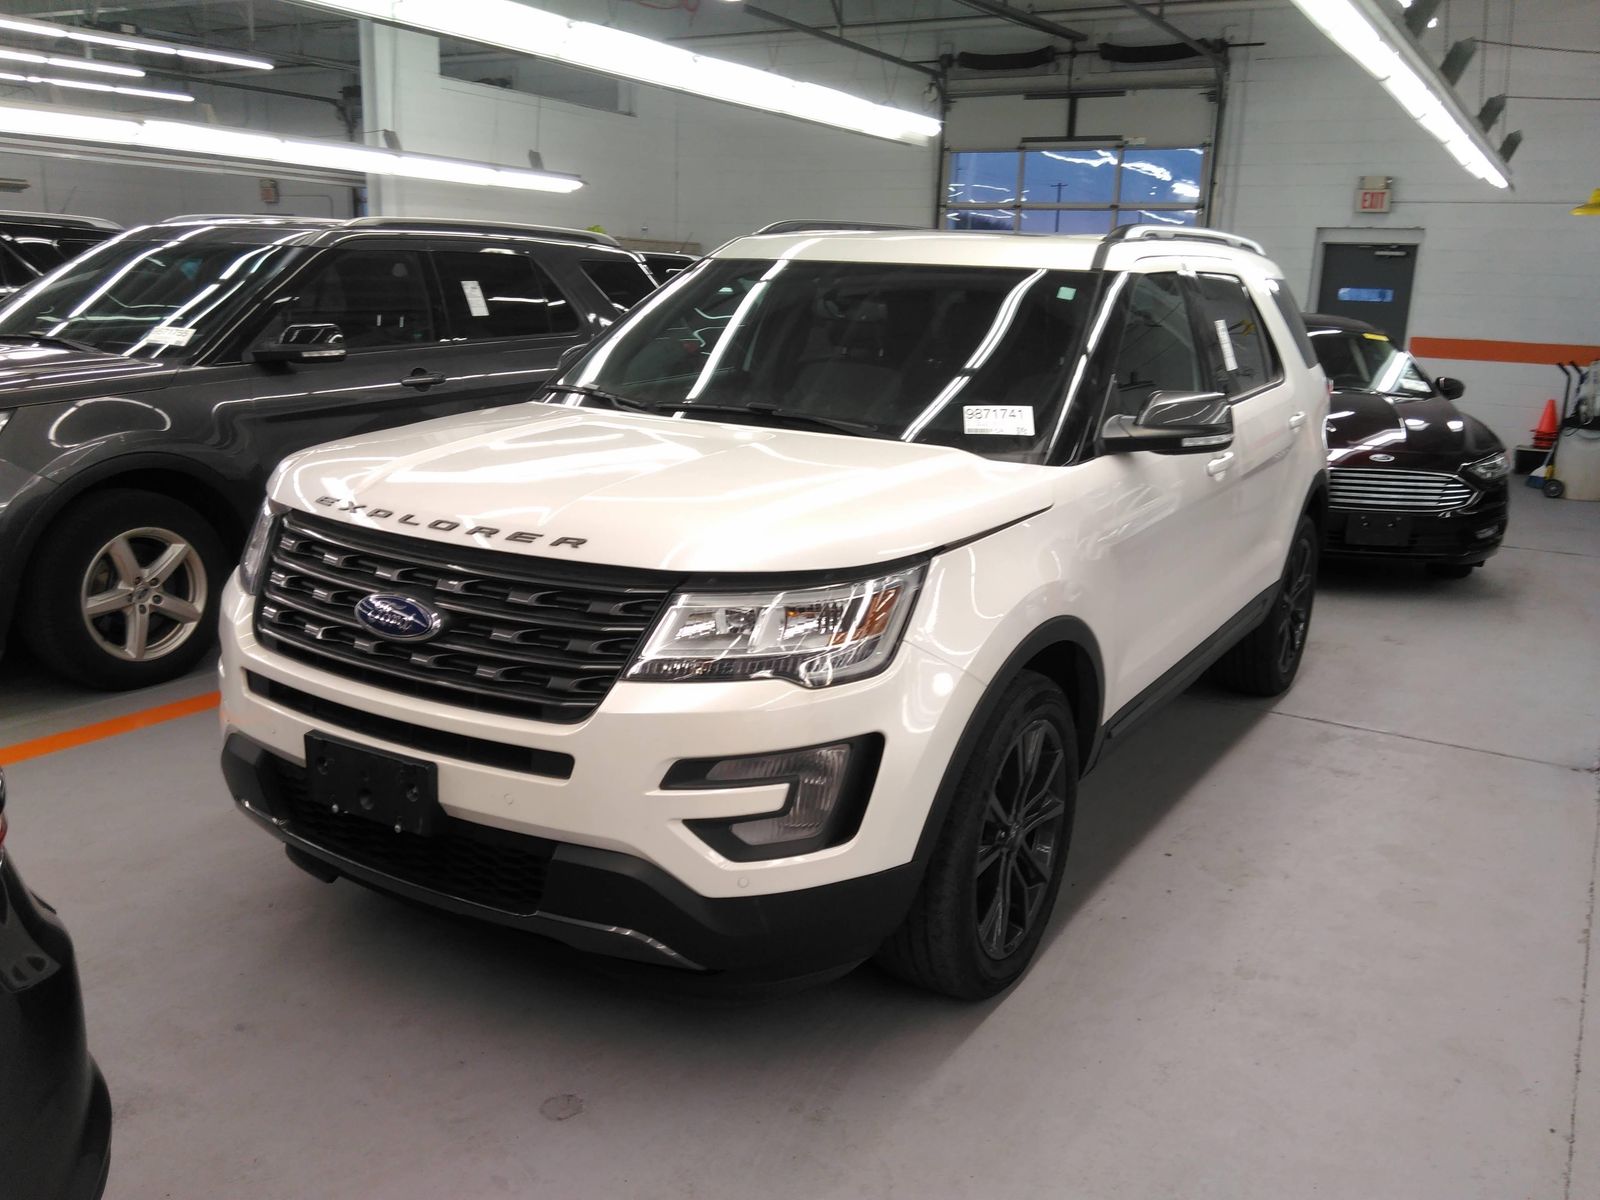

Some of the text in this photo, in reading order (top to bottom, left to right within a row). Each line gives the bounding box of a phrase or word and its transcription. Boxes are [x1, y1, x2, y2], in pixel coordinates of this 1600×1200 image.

[1361, 191, 1386, 209] EXIT
[966, 408, 1023, 420] 9871741
[315, 496, 588, 548] EXPLORER
